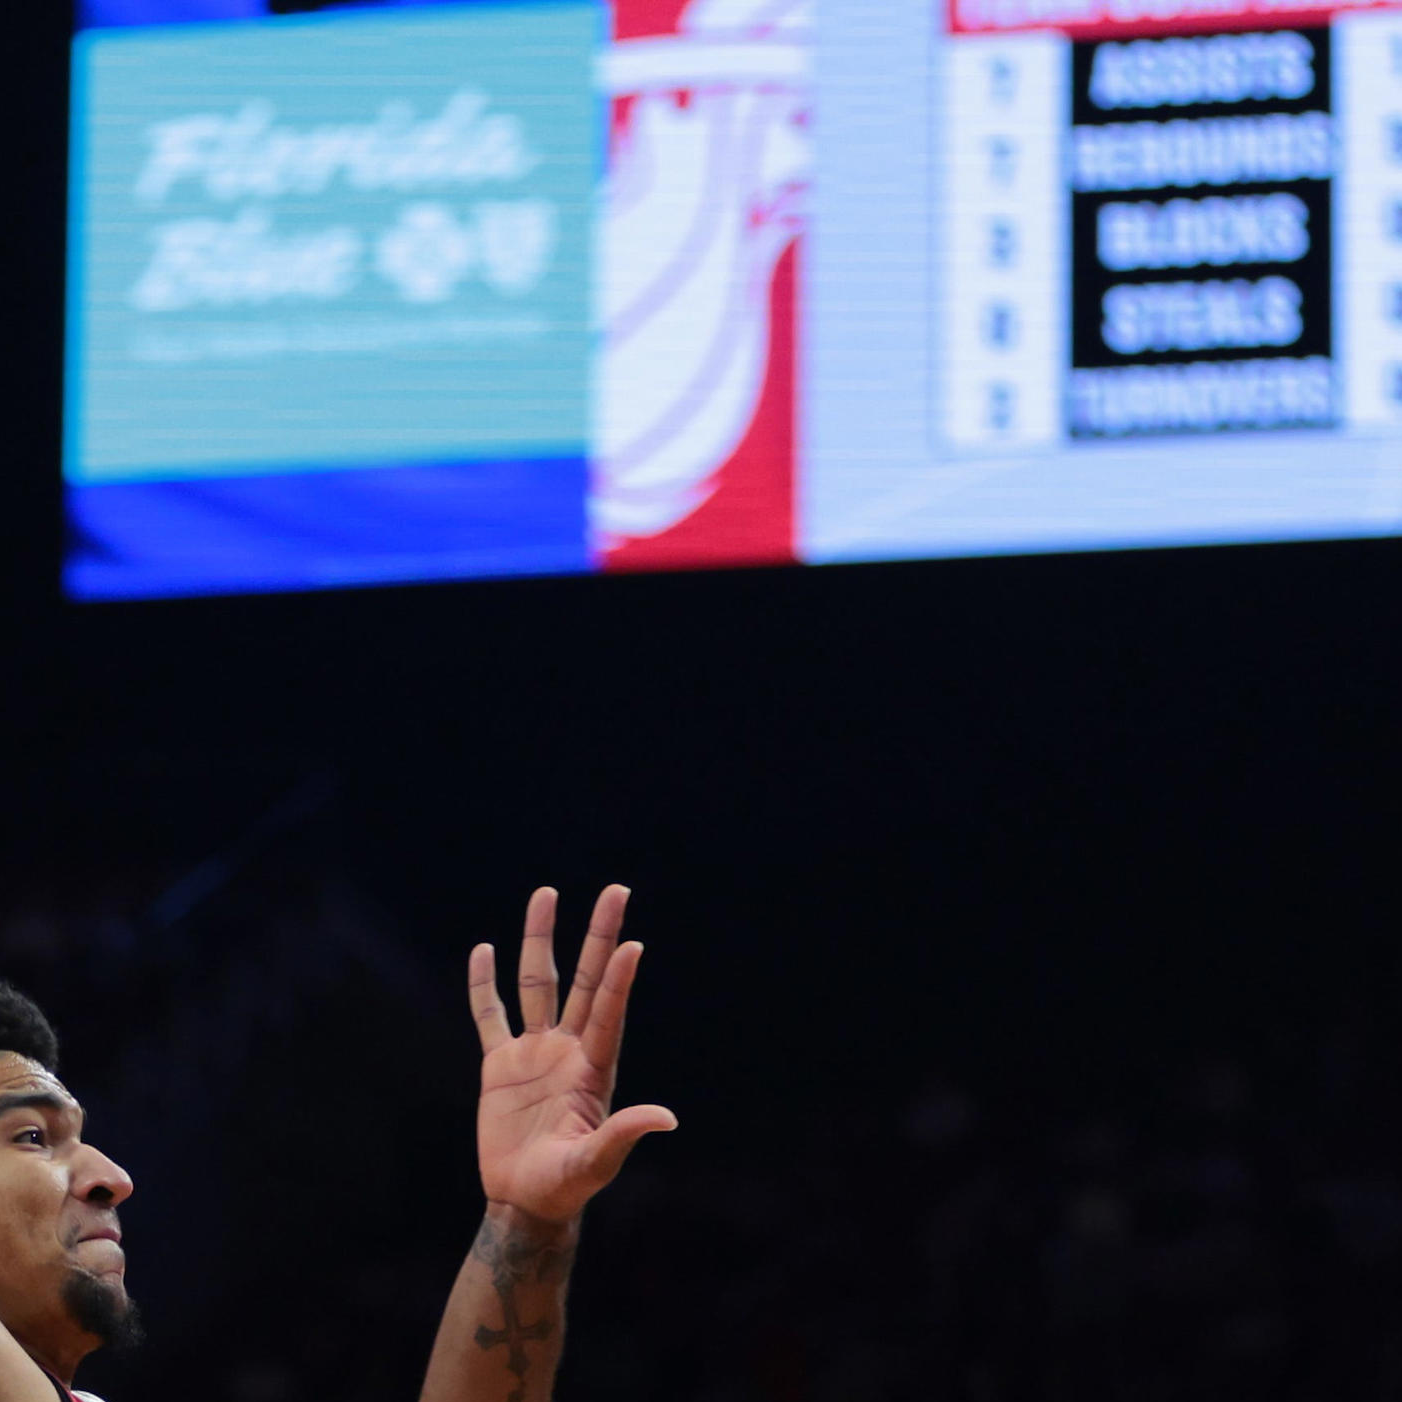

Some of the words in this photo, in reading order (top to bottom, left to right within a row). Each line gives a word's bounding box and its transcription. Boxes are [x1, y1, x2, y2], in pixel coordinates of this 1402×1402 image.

[136, 84, 534, 210] Florida
[129, 206, 362, 310] Blue
[1096, 192, 1310, 272] BLOCKS
[1100, 275, 1305, 354] STEALS
